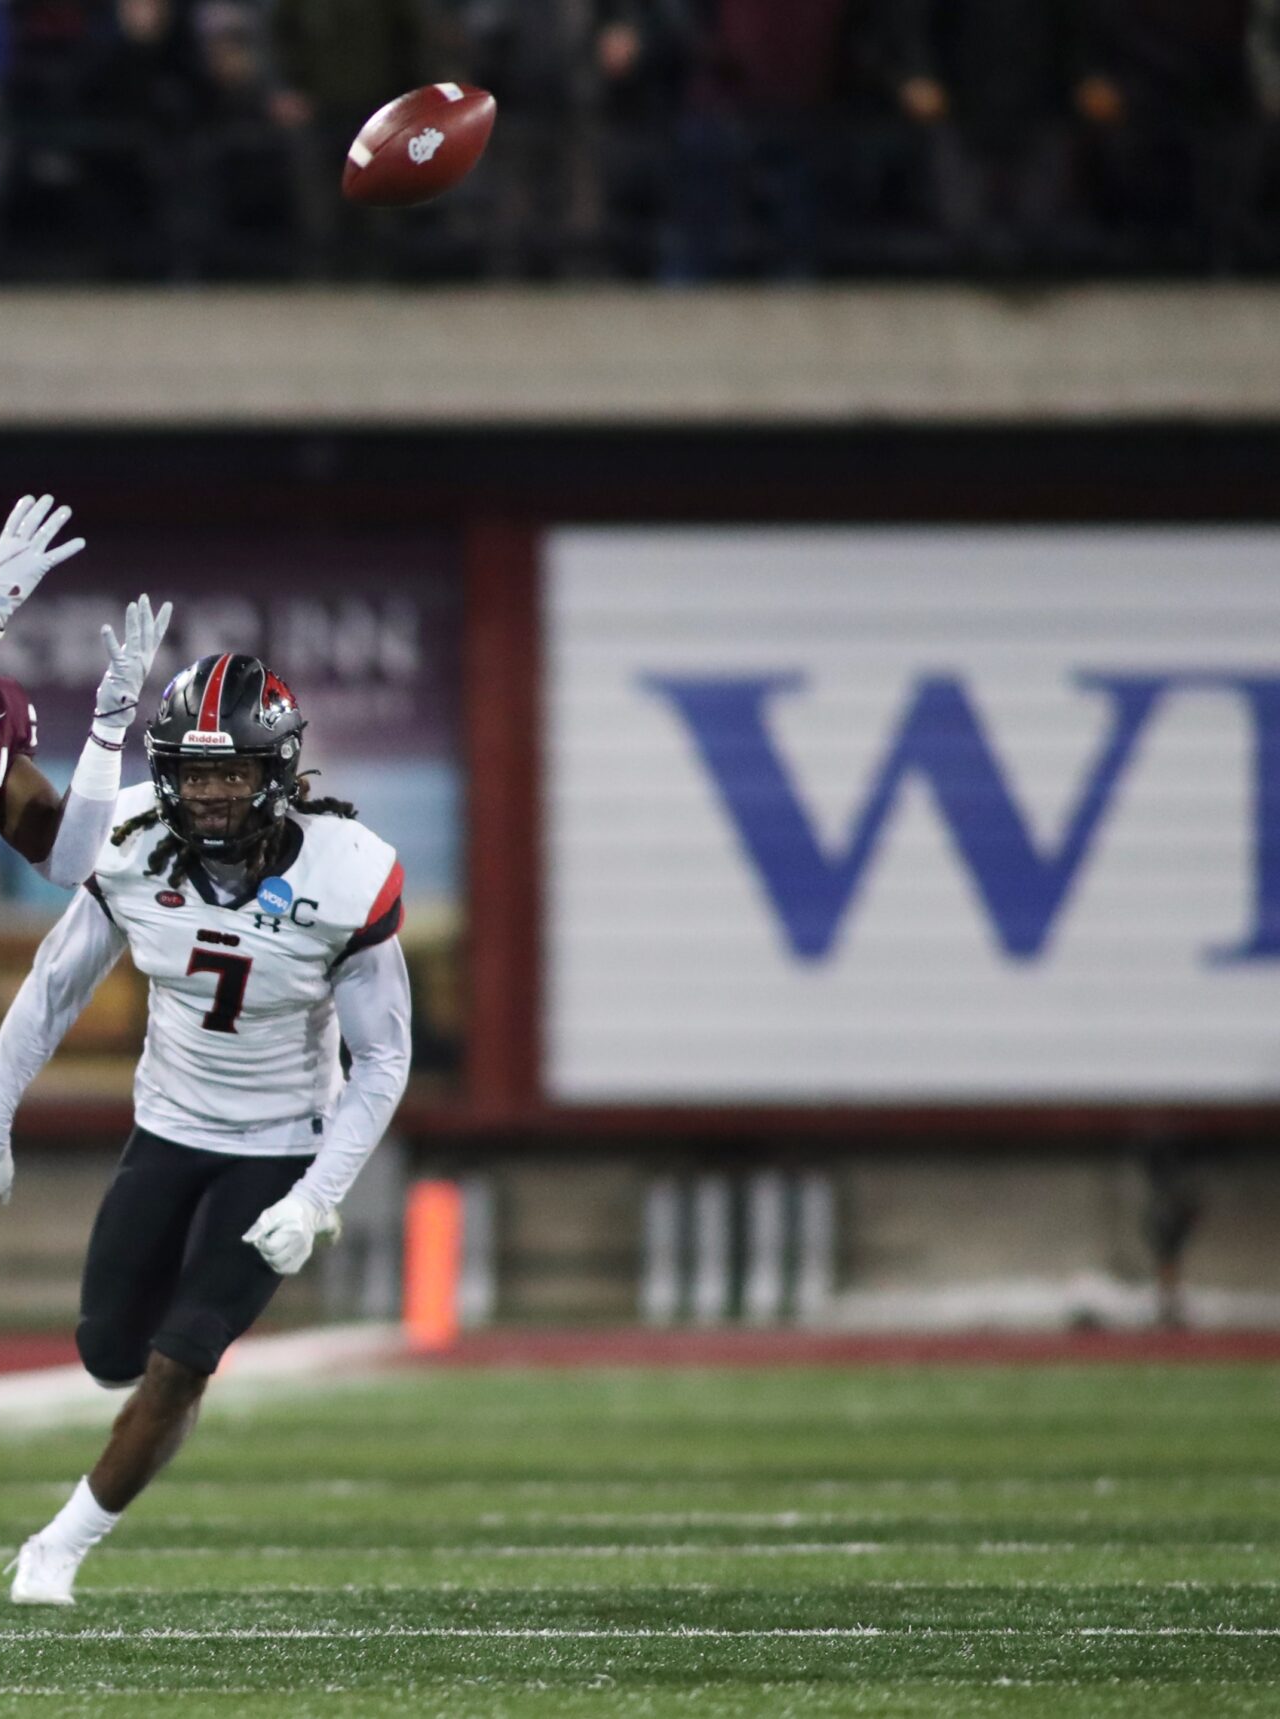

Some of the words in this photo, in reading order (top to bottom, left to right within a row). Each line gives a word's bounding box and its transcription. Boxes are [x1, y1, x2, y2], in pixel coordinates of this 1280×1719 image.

[187, 734, 226, 744] Riddell
[290, 897, 318, 927] C
[185, 947, 254, 1034] 7
